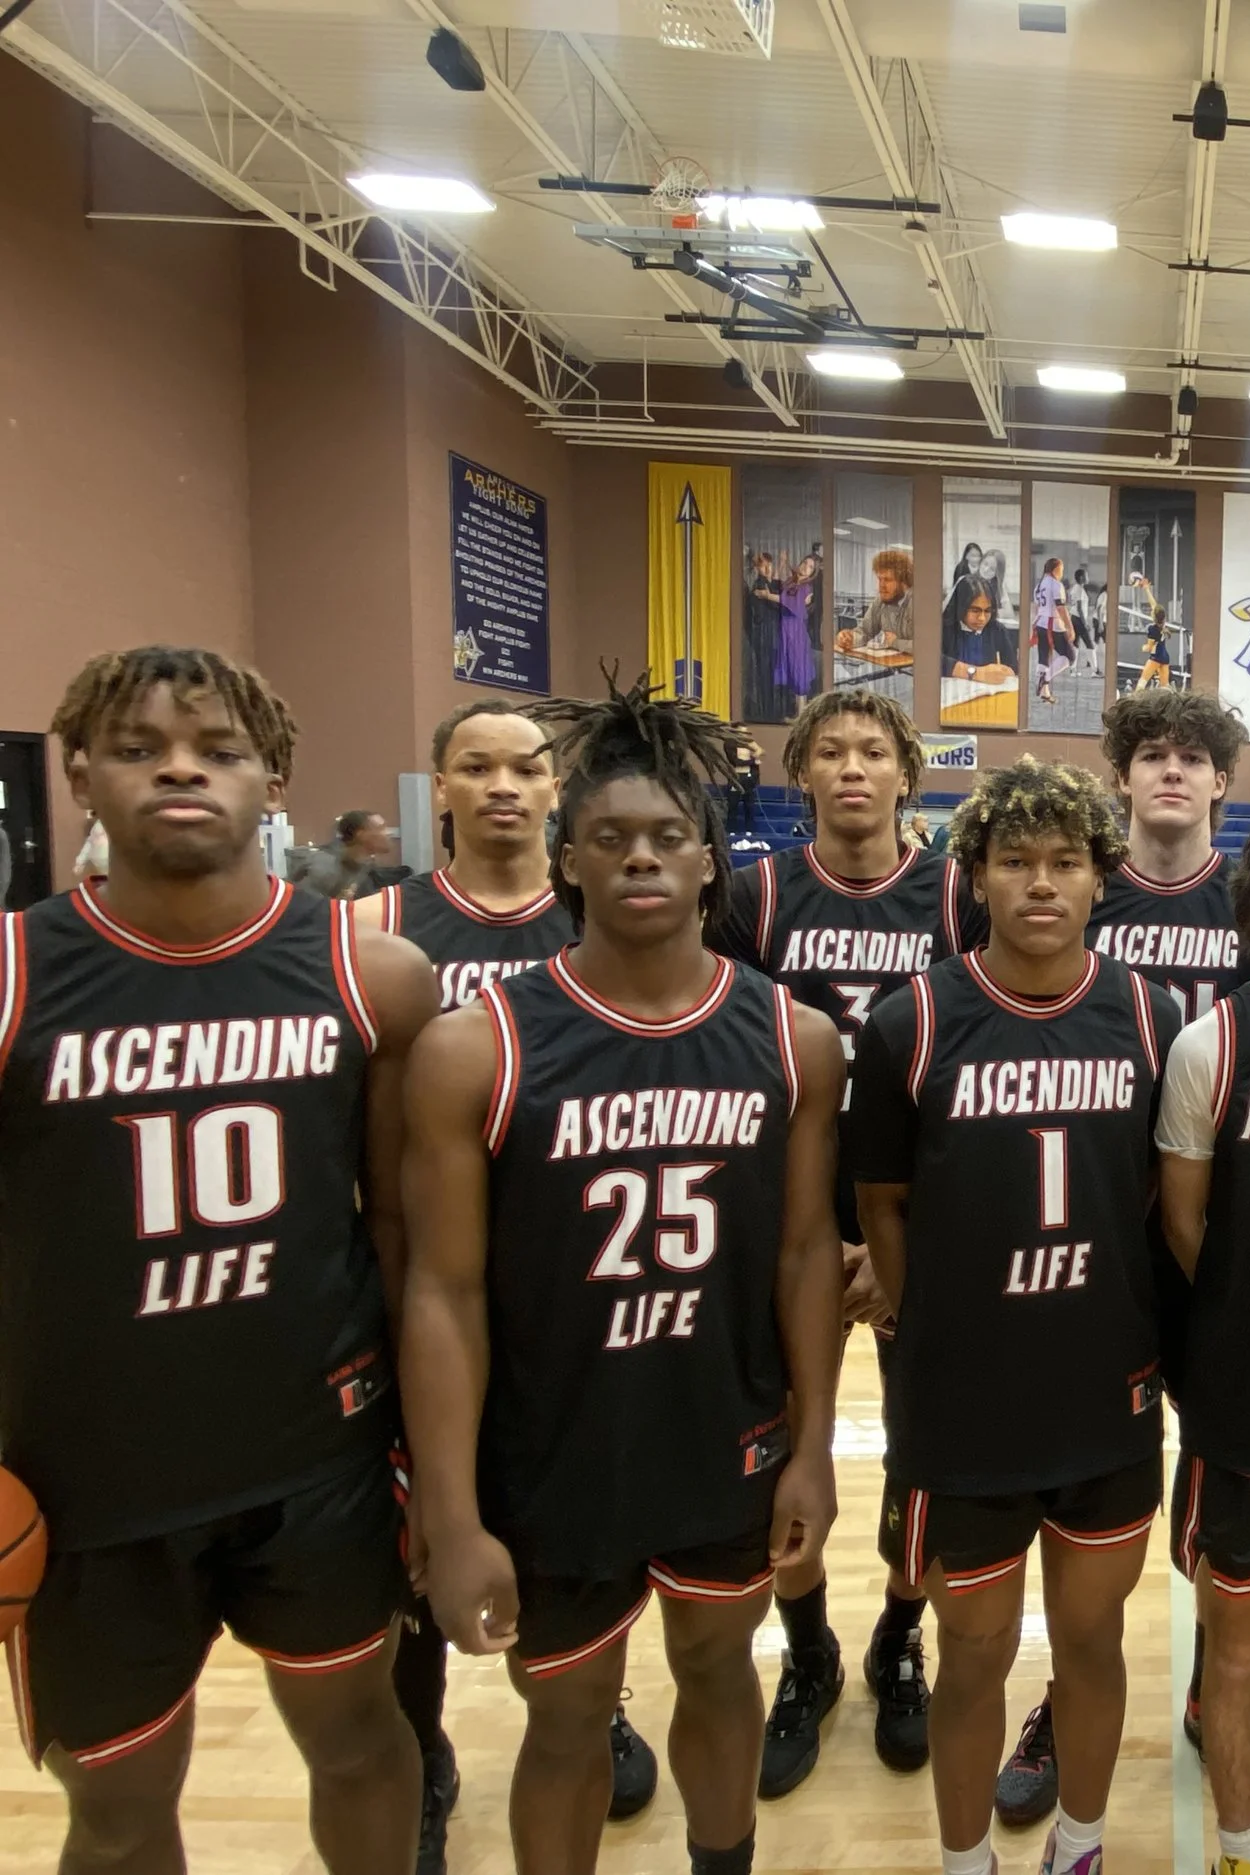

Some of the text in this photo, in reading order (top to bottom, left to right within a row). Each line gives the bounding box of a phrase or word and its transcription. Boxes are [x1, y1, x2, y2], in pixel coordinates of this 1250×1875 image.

[464, 468, 536, 513] ARCHERS
[777, 928, 933, 973] ASCENDING
[1094, 924, 1241, 970] ASCENDING
[45, 1014, 342, 1104] ASCENDING
[948, 1058, 1136, 1120] ASCENDING
[547, 1088, 769, 1162] ASCENDING
[112, 1101, 285, 1240] 10
[1028, 1126, 1069, 1231] 1
[583, 1161, 725, 1281] 25
[136, 1240, 277, 1319] LIFE
[1002, 1240, 1094, 1296] LIFE
[602, 1287, 703, 1350] LIFE
